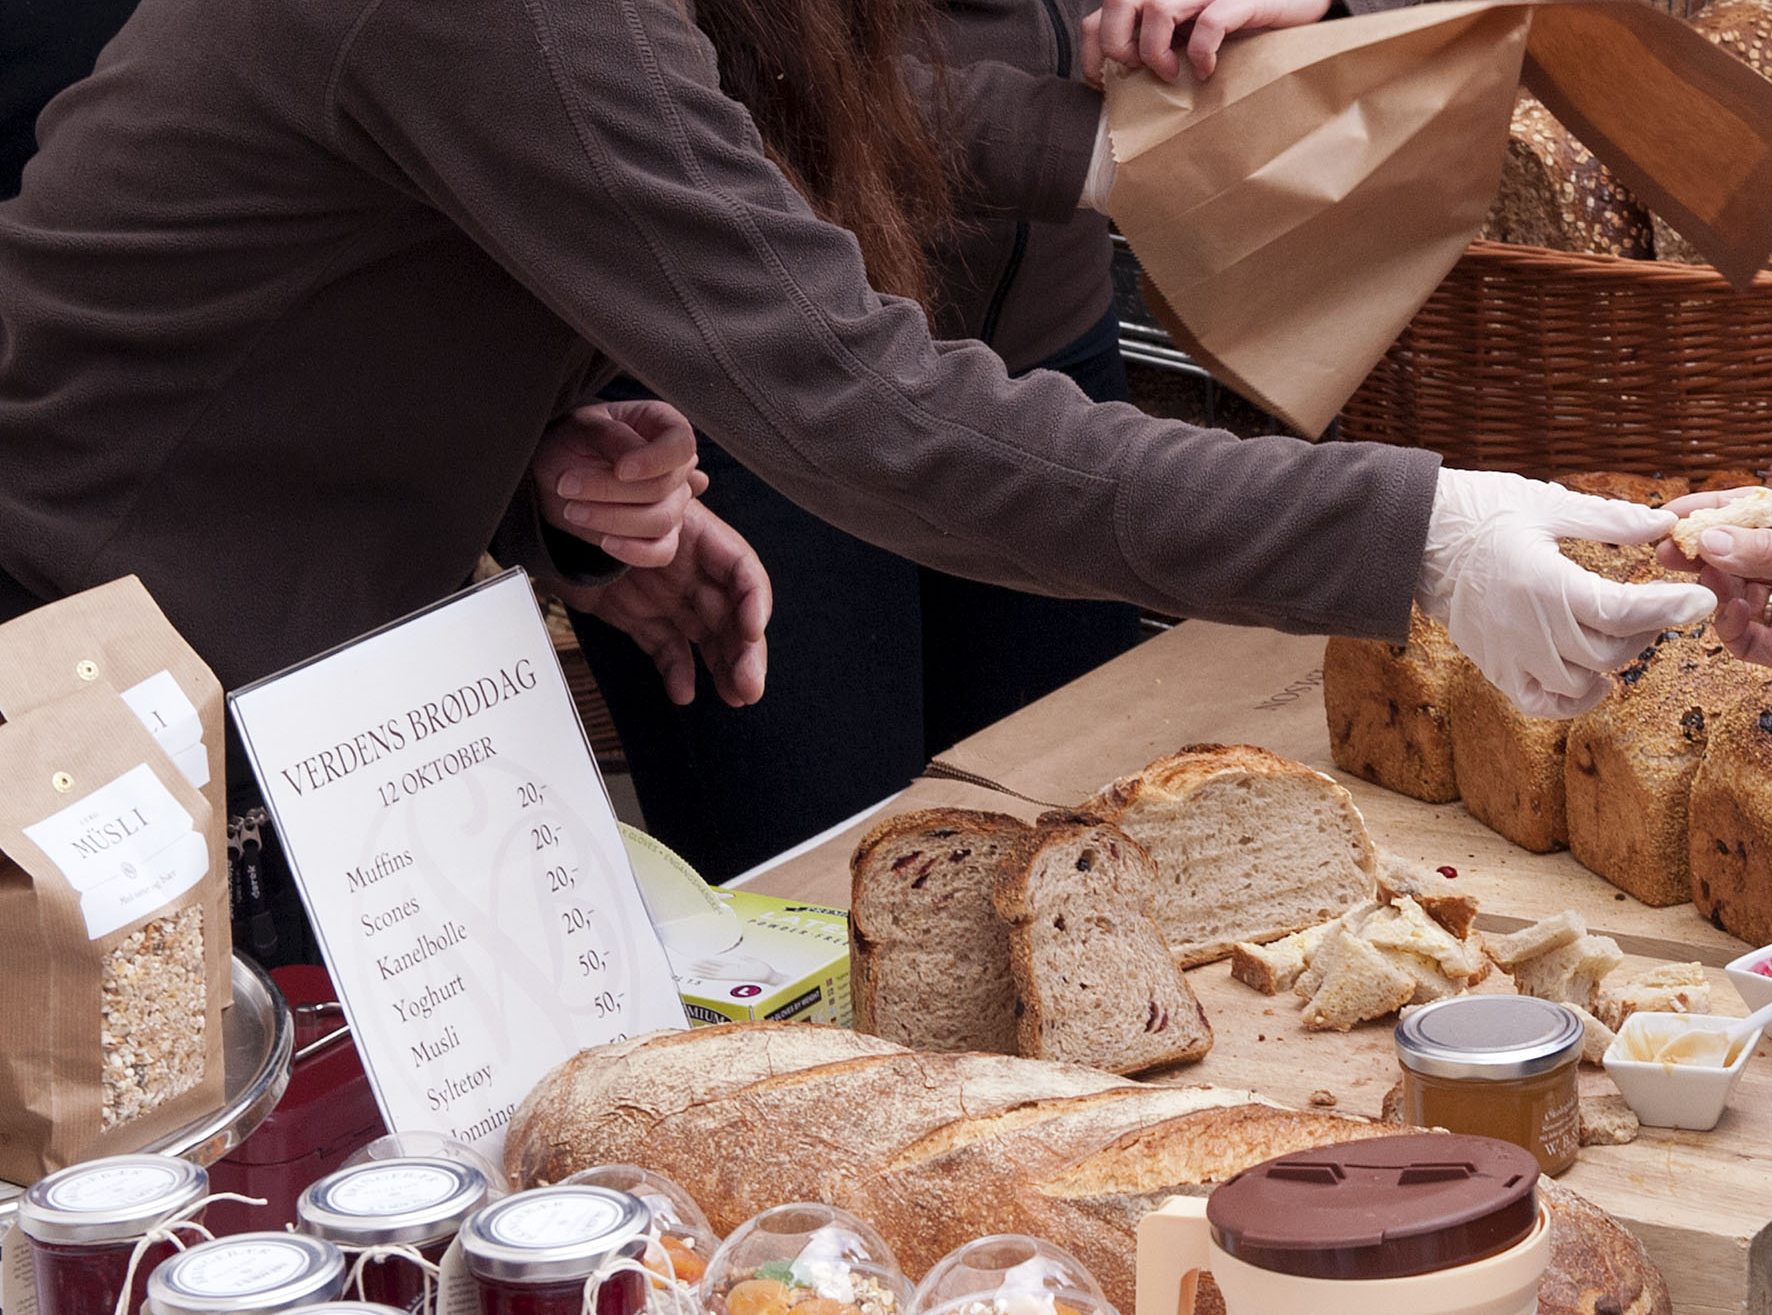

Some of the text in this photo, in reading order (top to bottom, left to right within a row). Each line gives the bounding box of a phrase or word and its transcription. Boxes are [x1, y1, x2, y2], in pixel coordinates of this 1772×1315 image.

[281, 658, 538, 797] VERDENS BRØDDAG
[377, 736, 498, 808] 12 OKTOBER
[71, 807, 149, 859] MÜSLI
[345, 781, 547, 894] Muffins 20,-
[361, 823, 562, 937] Scones 20,-
[376, 865, 579, 981] Kanelbolle 20,-
[392, 907, 595, 1023] Yoghurt 20,-
[410, 949, 610, 1069] Musli 50,-
[427, 990, 625, 1113] Syltetøy 50,-
[688, 1006, 726, 1025] MIUM
[451, 1103, 516, 1143] onning
